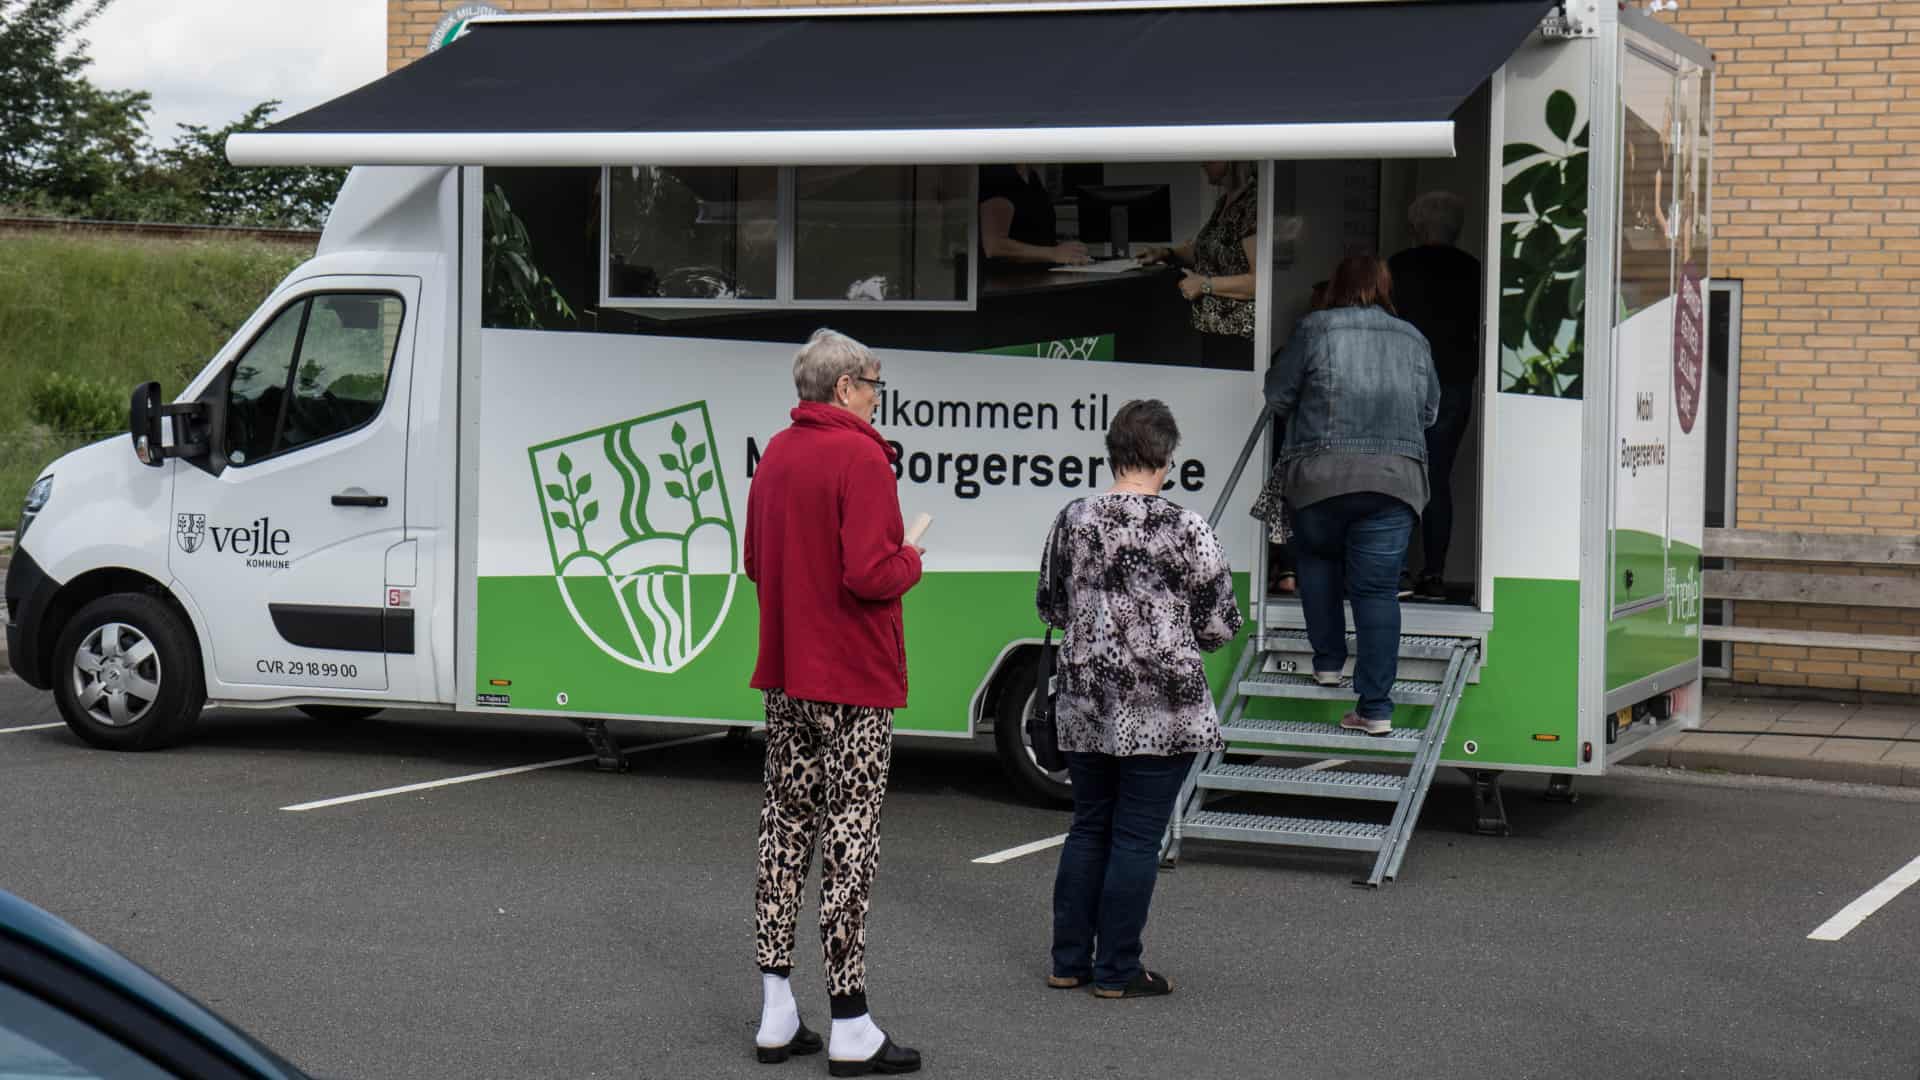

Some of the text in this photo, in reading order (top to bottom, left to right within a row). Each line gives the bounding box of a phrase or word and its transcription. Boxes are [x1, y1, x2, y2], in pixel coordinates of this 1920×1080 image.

[871, 390, 1108, 431] lkommen til
[1636, 391, 1654, 421] Mobil
[887, 439, 1205, 499] orgersere
[1621, 437, 1666, 477] Borgerservice
[209, 516, 290, 557] vejle
[246, 559, 290, 569] KOMMUNE
[256, 660, 358, 677] CVR 29 18 99 00
